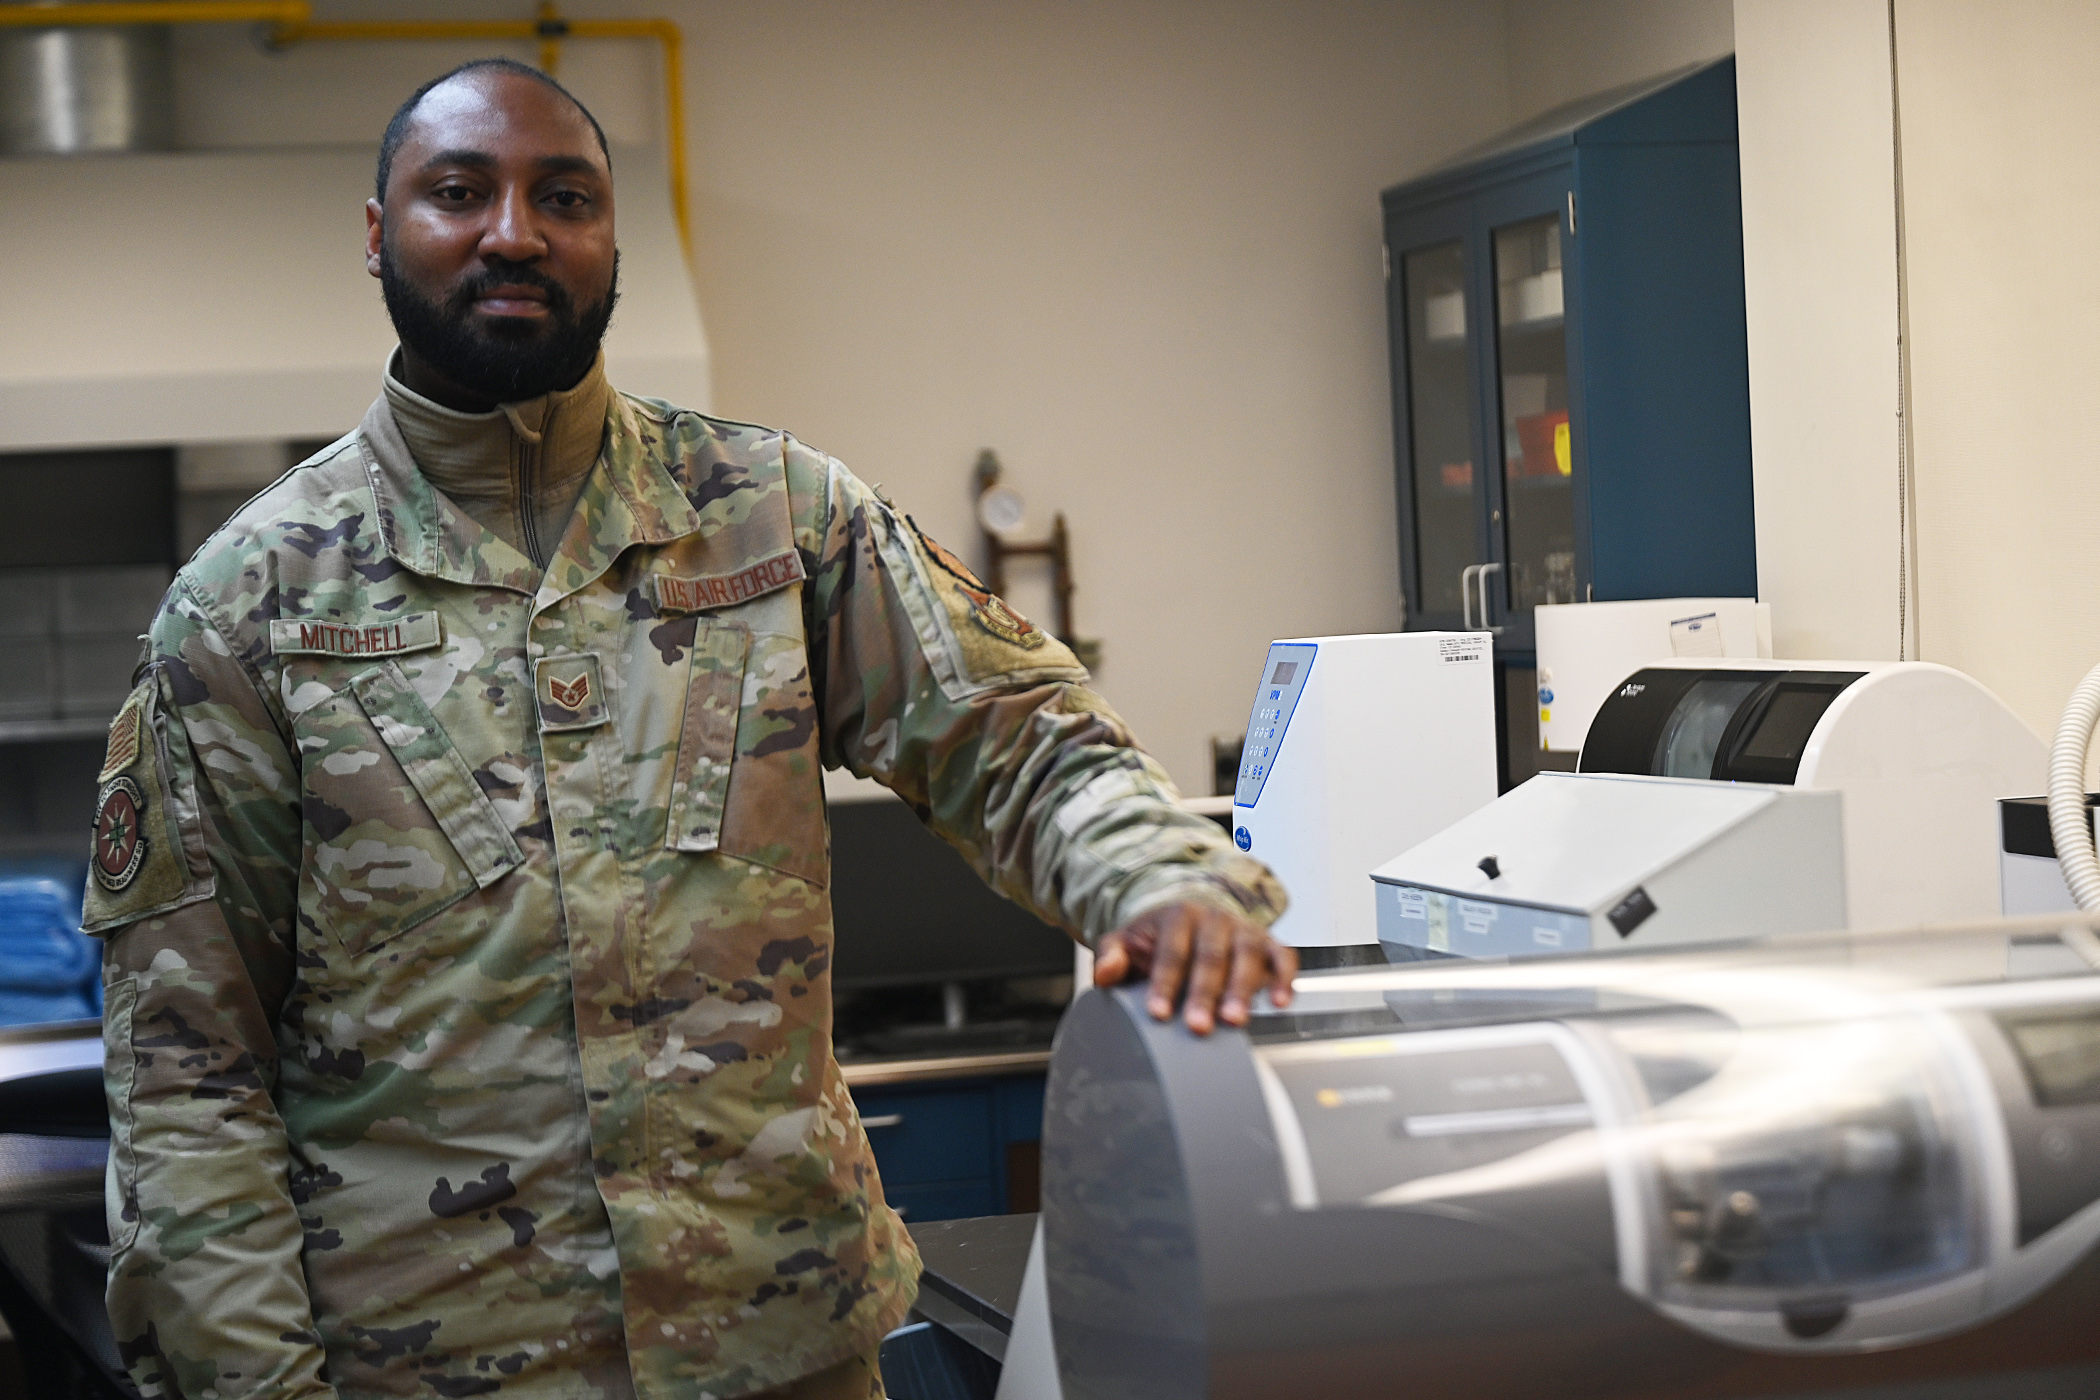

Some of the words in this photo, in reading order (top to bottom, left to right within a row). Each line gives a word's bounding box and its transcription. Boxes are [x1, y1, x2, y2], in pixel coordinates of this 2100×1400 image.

[694, 577, 732, 607] AIR
[728, 555, 800, 601] FORCE
[300, 623, 407, 654] MITCHELL
